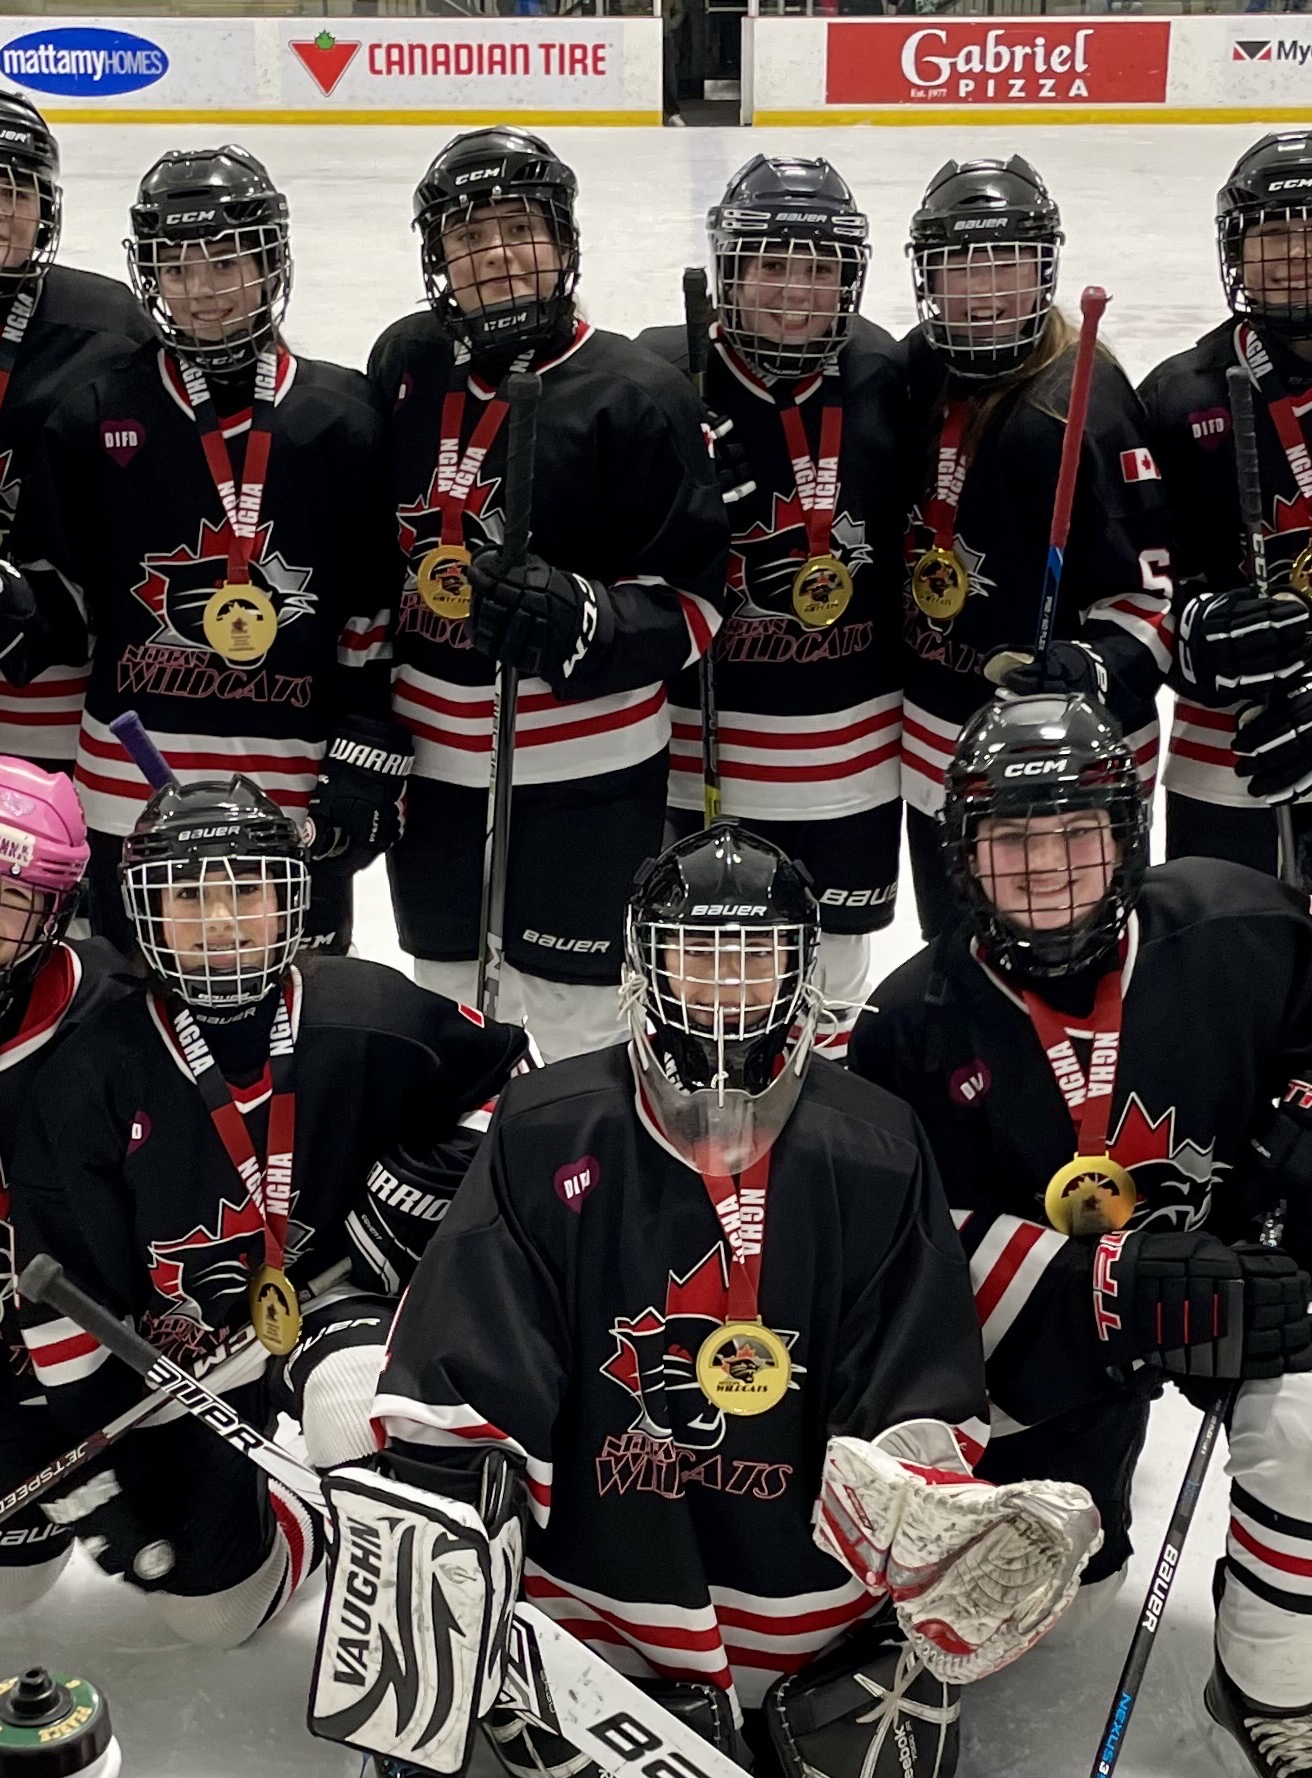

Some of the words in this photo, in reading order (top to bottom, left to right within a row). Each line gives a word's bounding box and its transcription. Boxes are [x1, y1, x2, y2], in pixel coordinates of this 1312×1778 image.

[368, 42, 530, 77] CANADIAN
[535, 42, 607, 76] TIRE
[900, 28, 1094, 86] Gabriel
[958, 79, 1089, 97] PIZZA
[454, 167, 501, 187] CCM
[166, 209, 217, 226] CCM
[775, 211, 828, 224] BAUER
[953, 216, 1010, 232] BAUER
[2, 292, 34, 344] NGHA
[254, 350, 279, 402] NGHA
[104, 430, 138, 449] DIFD
[1191, 418, 1225, 440] DIFD
[437, 437, 460, 493] NGHA
[449, 446, 488, 500] NGHA
[815, 456, 839, 511] NGHA
[936, 446, 958, 502] NGHA
[236, 483, 263, 538] NGHA
[117, 660, 314, 708] WILDCATS
[1004, 758, 1068, 780] CCM
[178, 824, 242, 842] BAUER
[691, 903, 767, 918] BAUER
[523, 928, 610, 954] BAUER
[173, 1008, 215, 1077] NGHA
[1087, 1031, 1120, 1099] NGHA
[1047, 1038, 1089, 1108] NGHA
[266, 1152, 294, 1216] NGHA
[739, 1187, 766, 1256] NGHA
[333, 1516, 383, 1688] VAUGHN
[1142, 1543, 1179, 1635] BAUER
[893, 1724, 915, 1778] eebok
[1102, 1691, 1132, 1763] NEXUS
